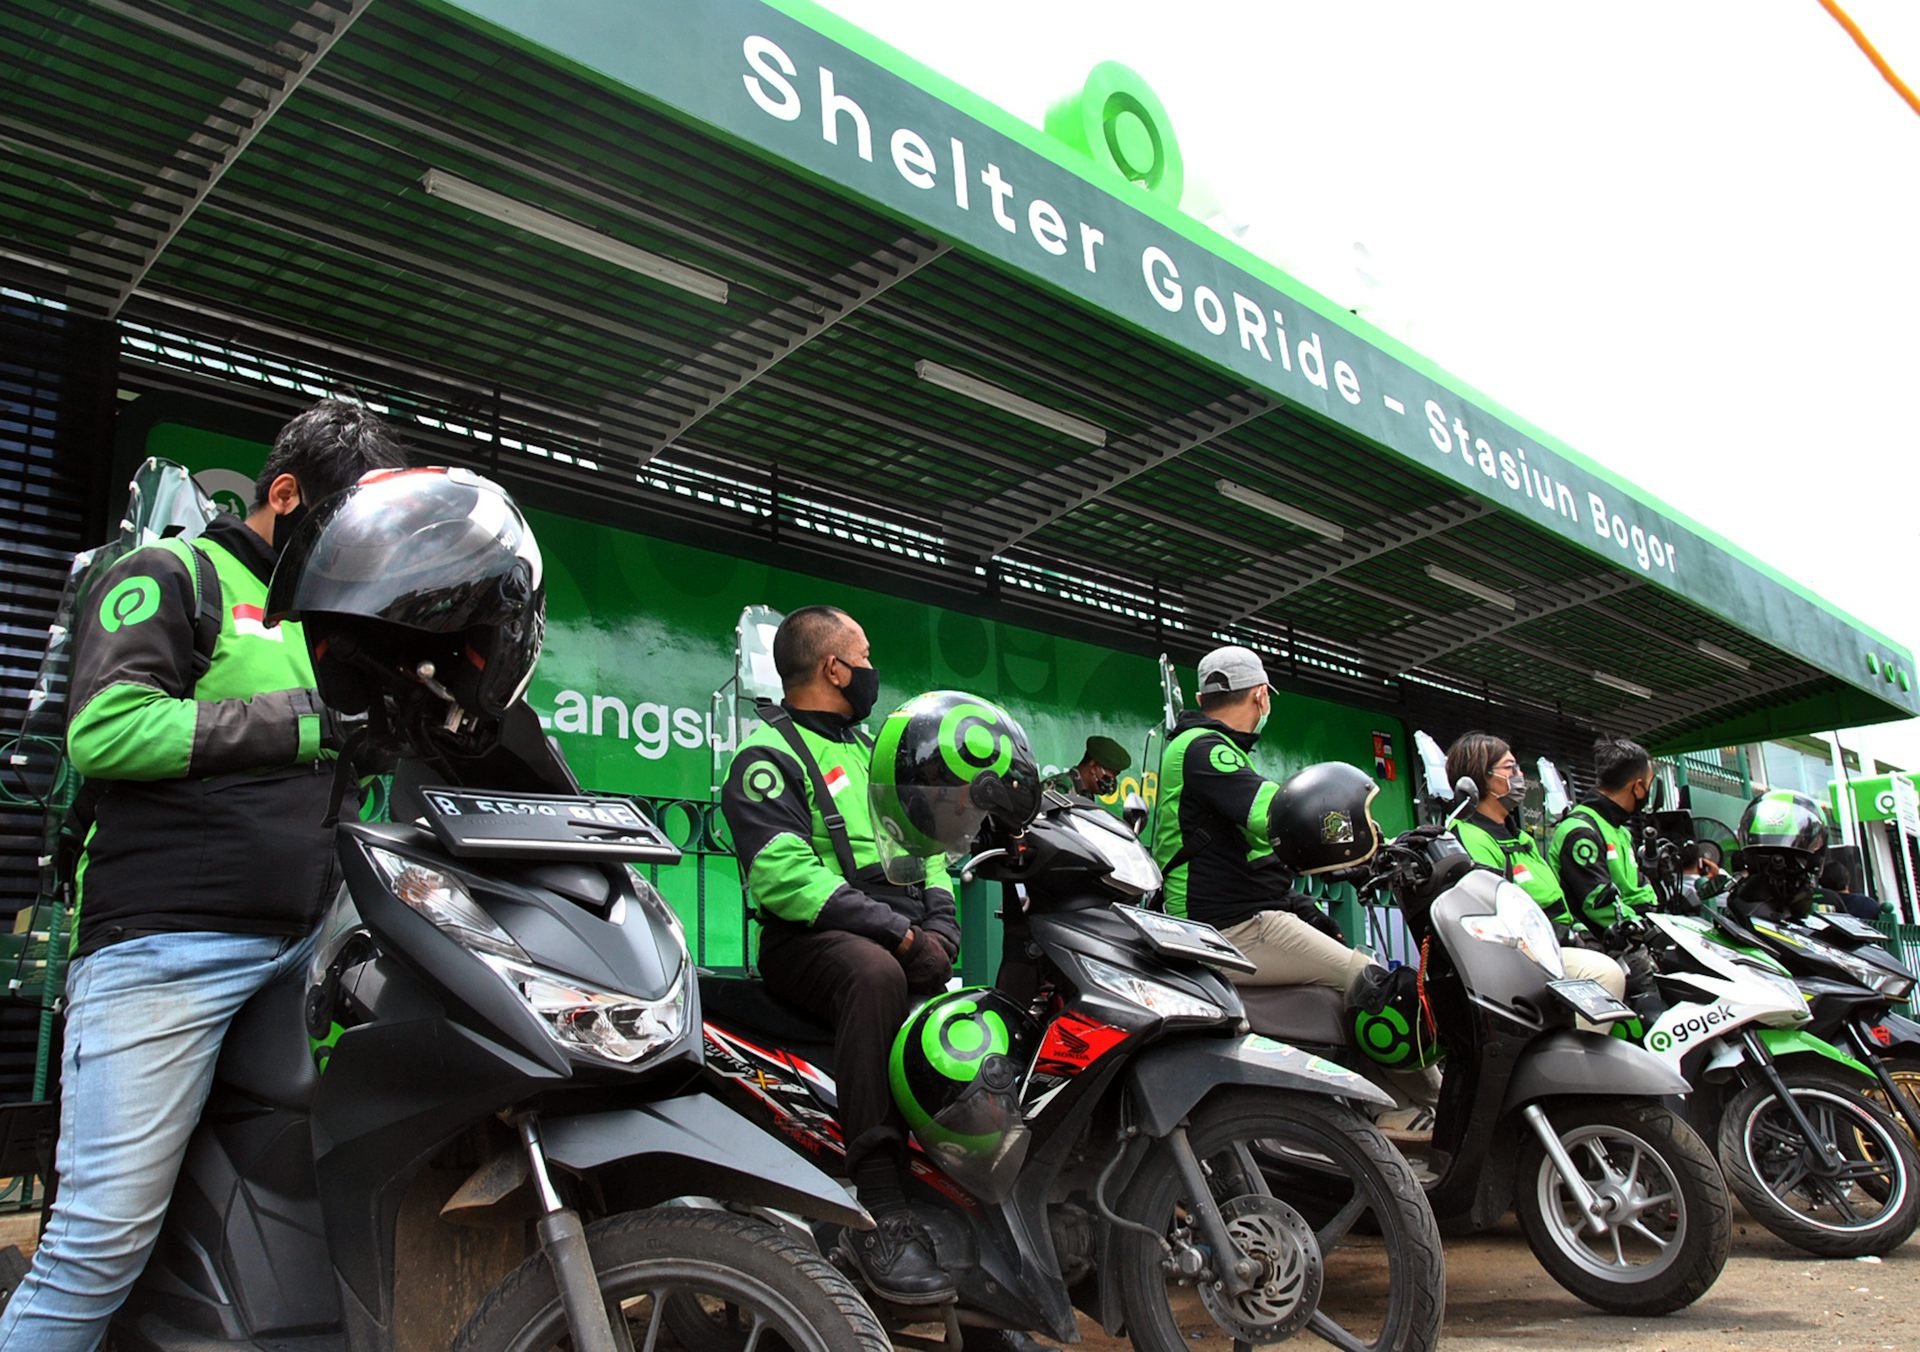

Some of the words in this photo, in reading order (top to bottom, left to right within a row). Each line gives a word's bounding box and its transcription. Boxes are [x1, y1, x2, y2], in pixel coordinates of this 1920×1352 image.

[742, 35, 1104, 273] Shelter
[1141, 246, 1361, 405] GoRide
[1424, 400, 1578, 523] Stasiun
[1588, 491, 1677, 571] Bogor
[434, 796, 462, 815] B
[1672, 1005, 1736, 1042] gojek
[1053, 1050, 1090, 1061] HONDA
